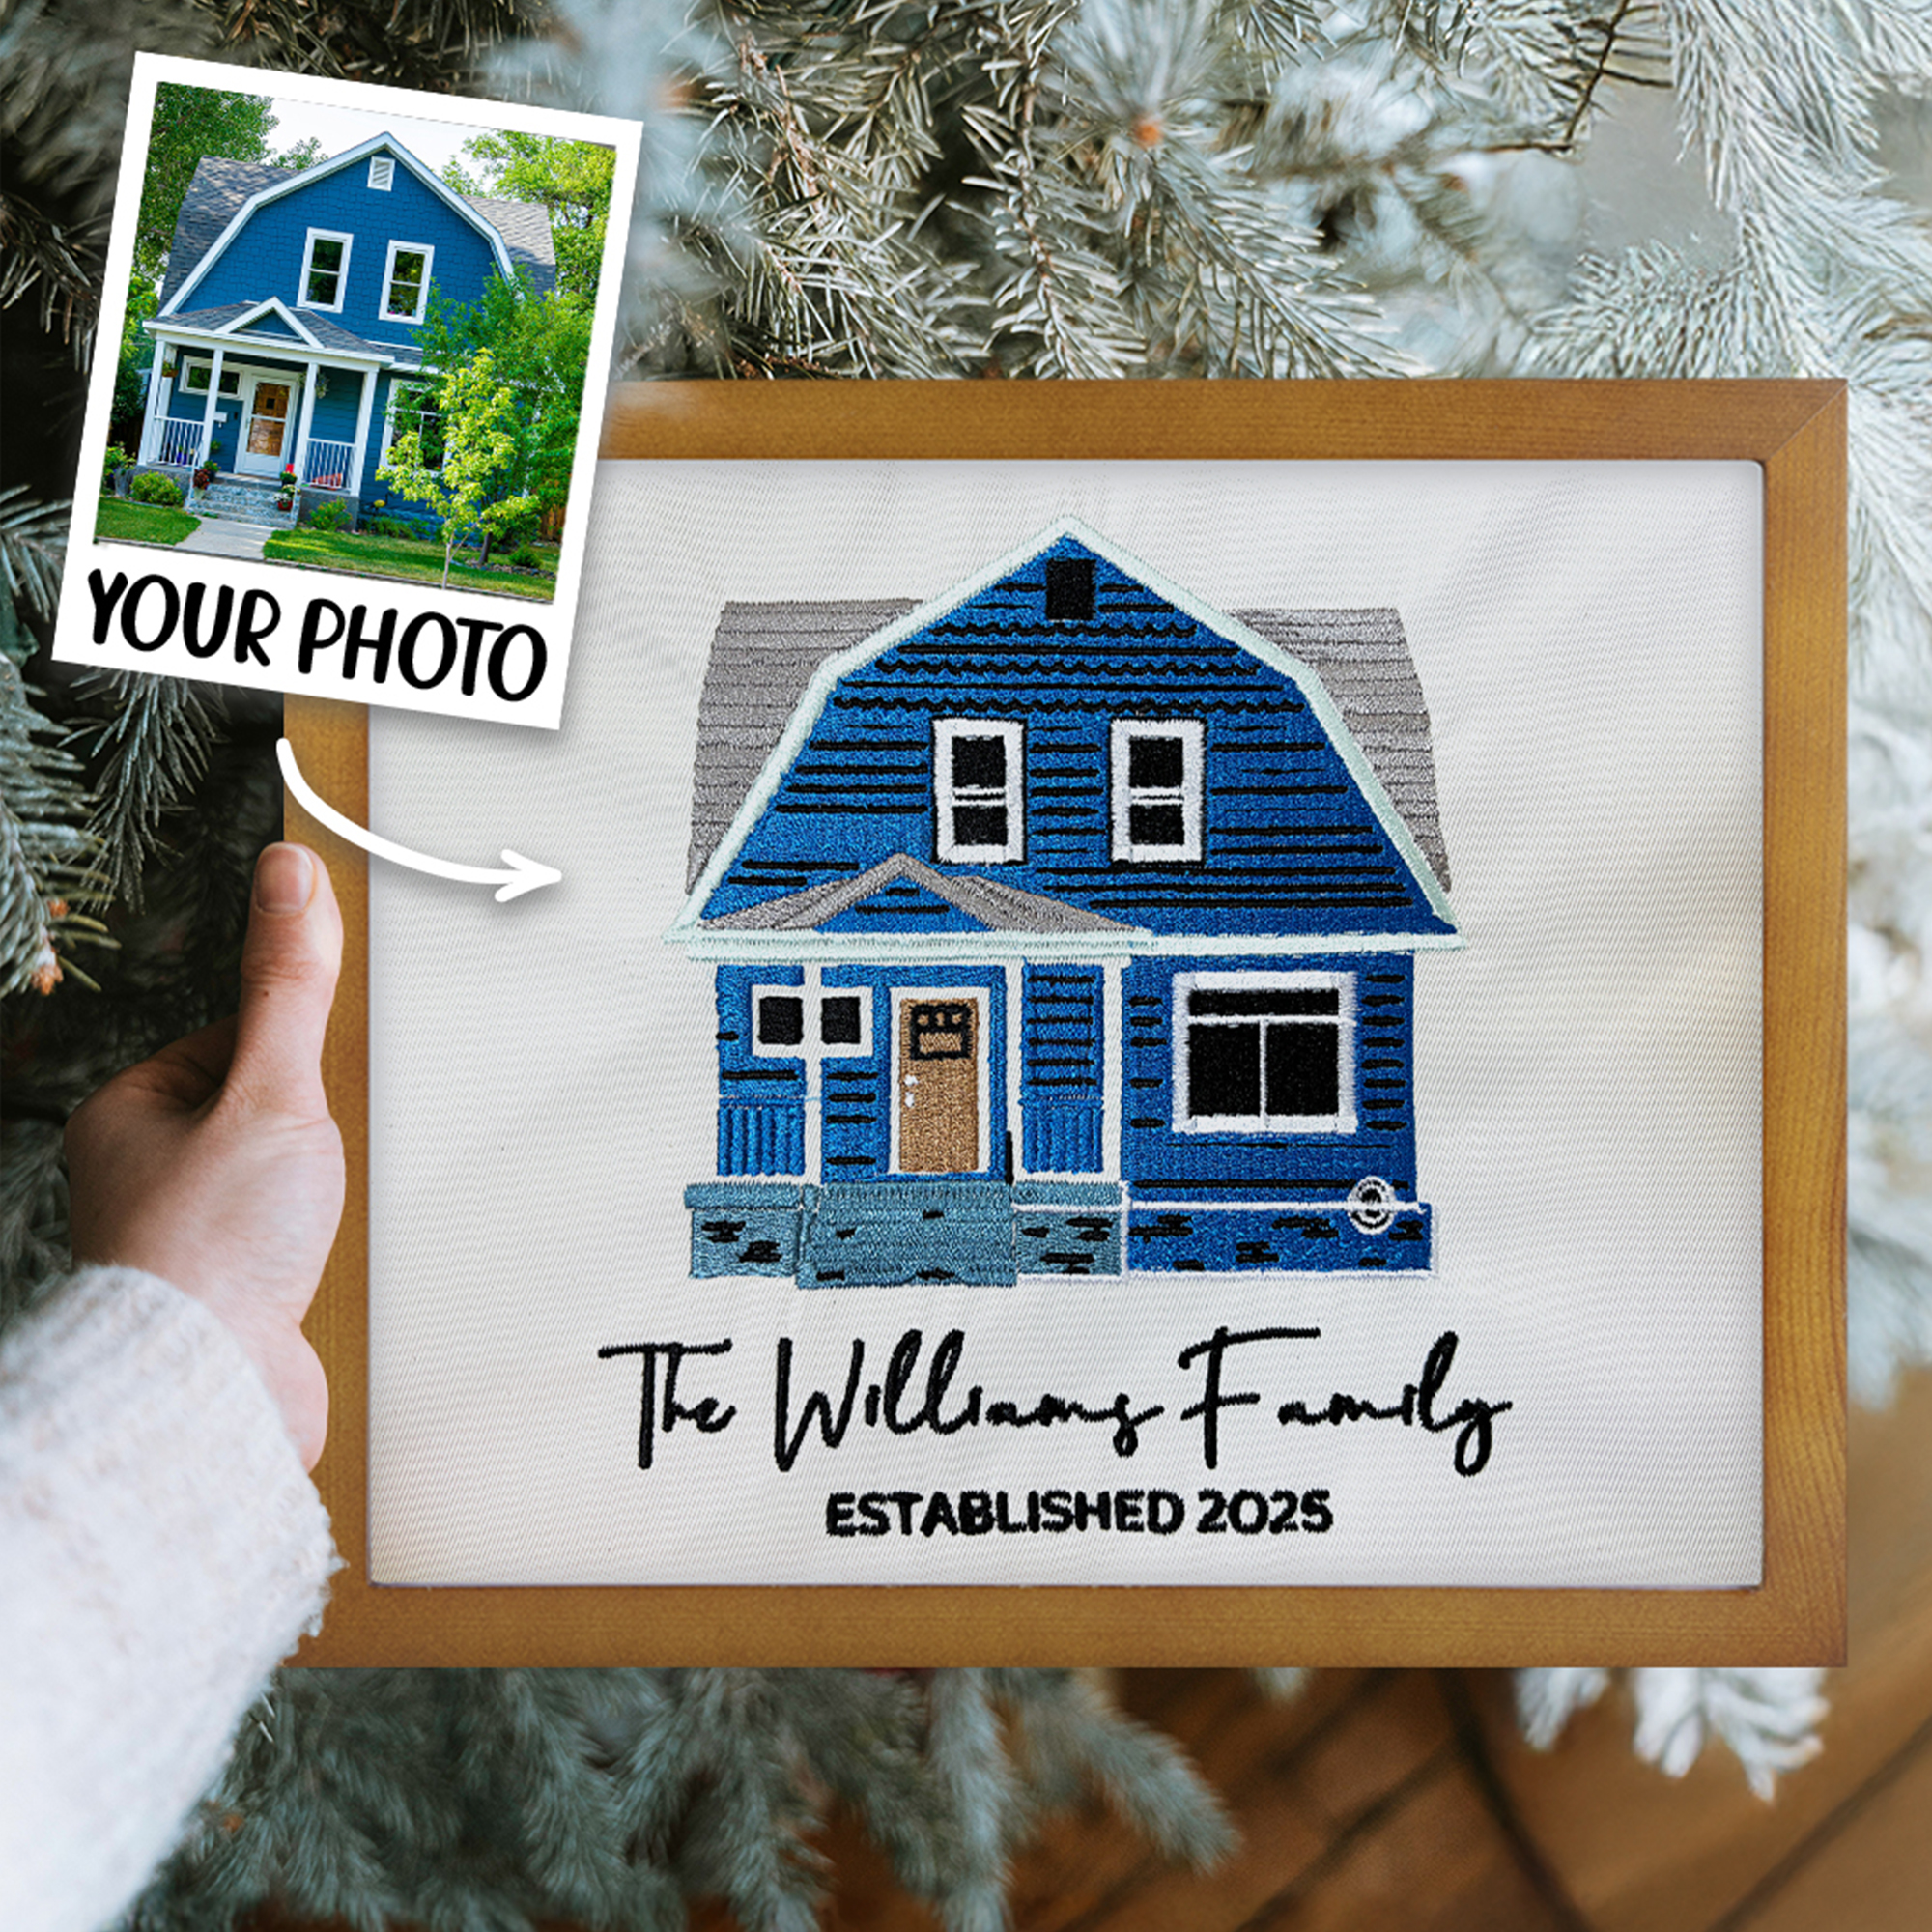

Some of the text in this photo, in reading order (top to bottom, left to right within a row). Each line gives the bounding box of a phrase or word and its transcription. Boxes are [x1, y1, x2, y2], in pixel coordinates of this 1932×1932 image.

[597, 1325, 1514, 1478] The Williams Family
[825, 1489, 1334, 1538] ESTABLISHED 2025
